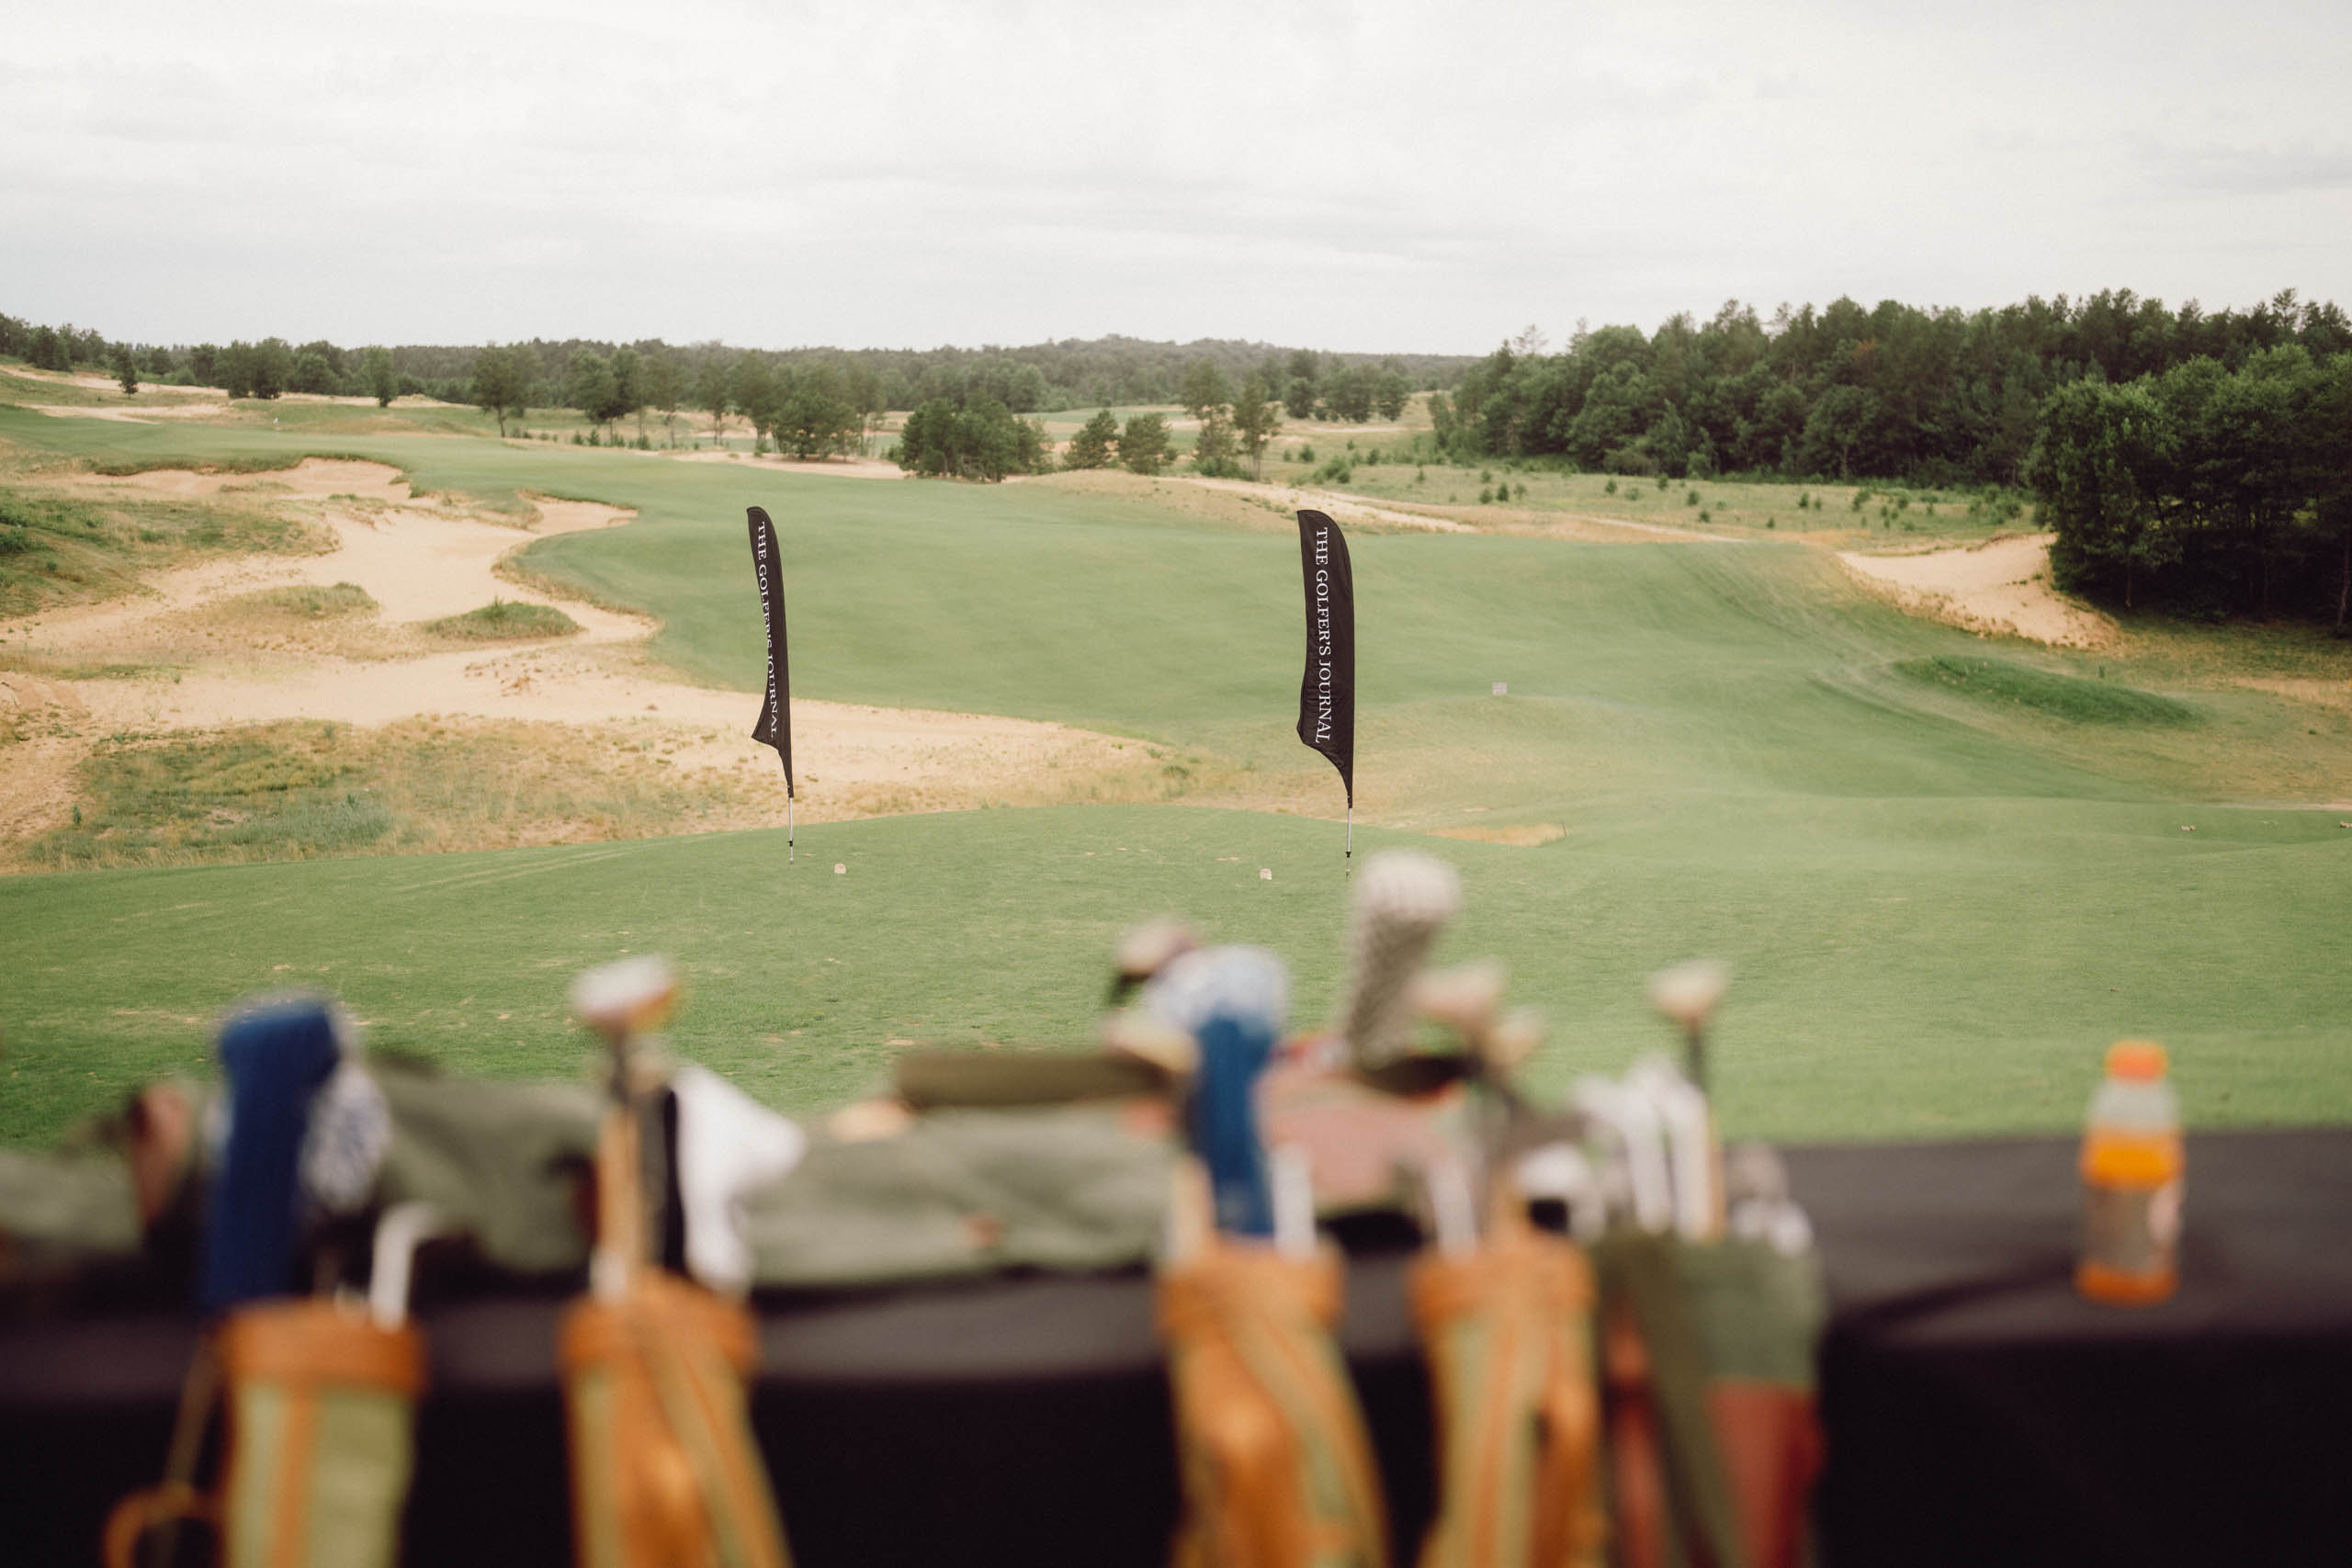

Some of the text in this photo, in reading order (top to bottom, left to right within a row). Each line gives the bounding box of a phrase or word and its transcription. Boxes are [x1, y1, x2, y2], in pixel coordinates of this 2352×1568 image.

[758, 521, 767, 560] THE
[1315, 527, 1332, 743] THE GOLFER'S JOURNAL
